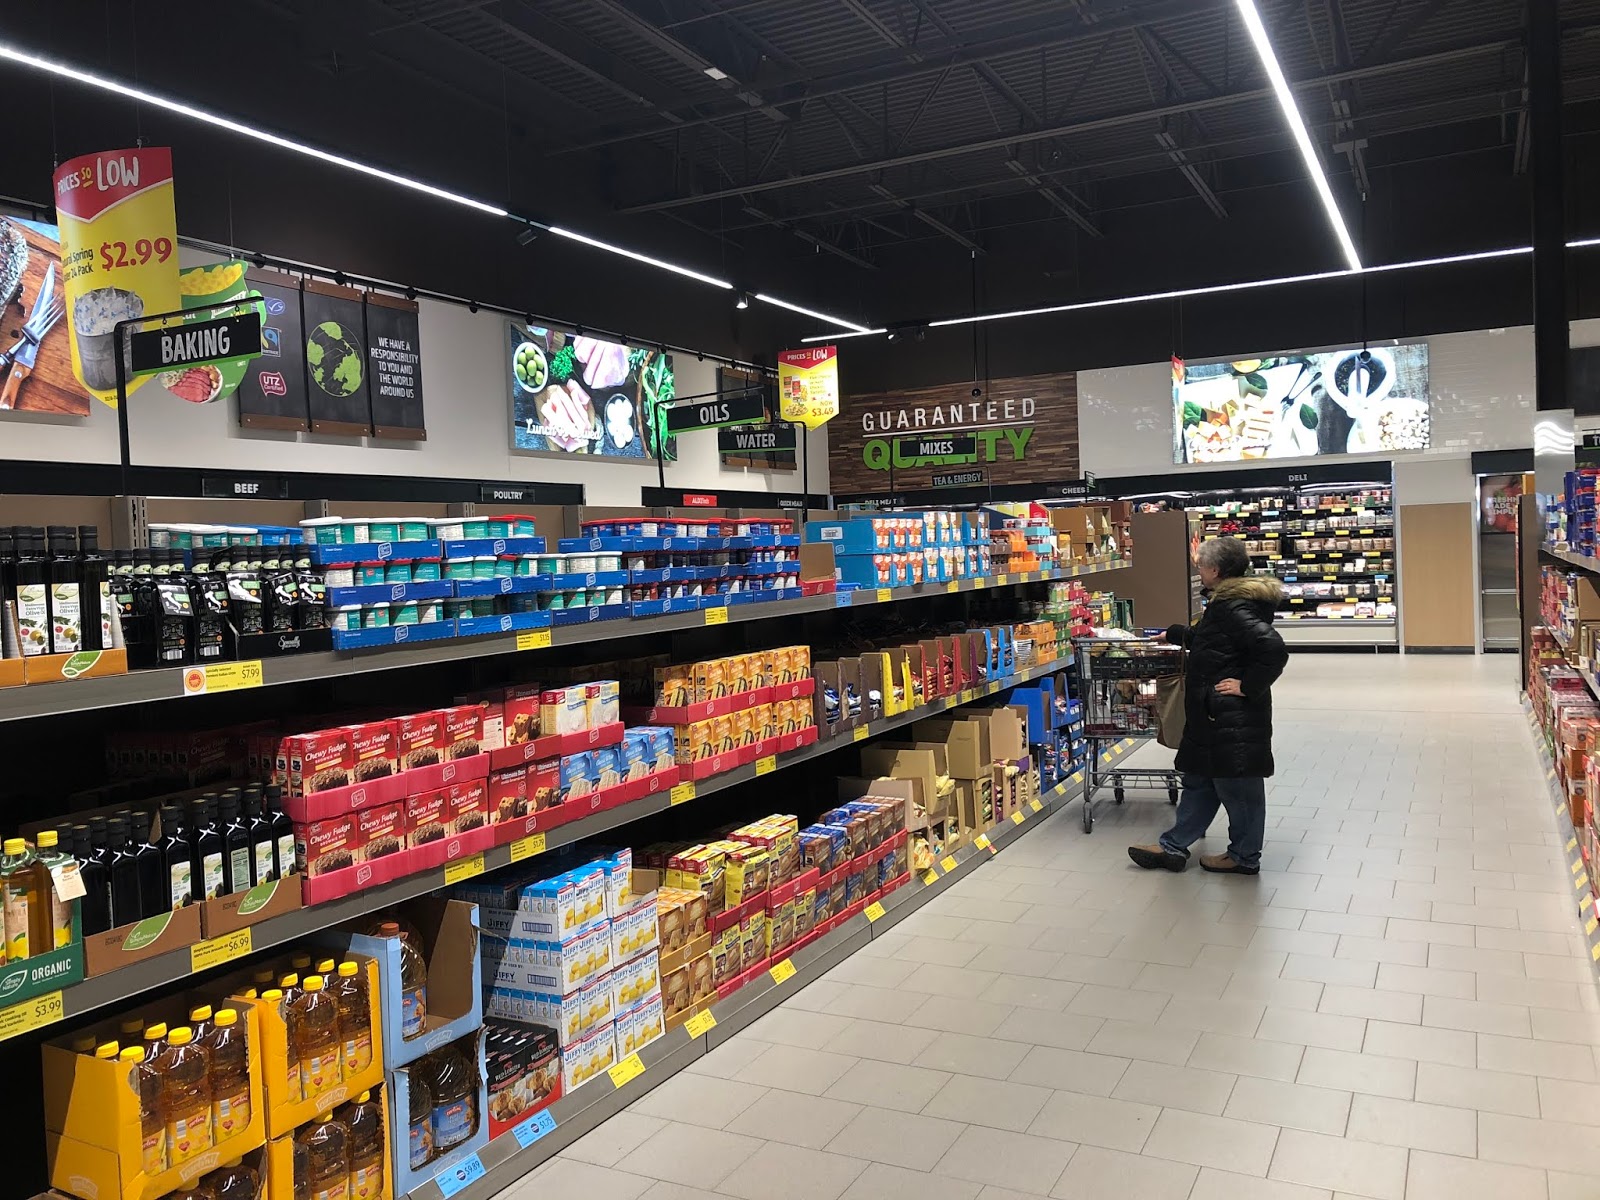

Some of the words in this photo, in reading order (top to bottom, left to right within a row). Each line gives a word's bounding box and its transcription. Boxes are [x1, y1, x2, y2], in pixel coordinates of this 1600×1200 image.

[58, 172, 80, 195] PRICES
[81, 167, 92, 181] SO
[97, 156, 139, 191] LOW
[73, 248, 94, 262] Spring
[100, 237, 172, 271] $2.99
[71, 267, 77, 278] 24
[77, 262, 94, 276] Pack
[161, 326, 230, 363] BAKING
[378, 337, 389, 347] WE
[389, 339, 406, 350] HAVE
[406, 342, 411, 351] A
[370, 347, 419, 364] RESPONSIBILITY
[787, 352, 806, 361] PRICES
[812, 349, 828, 360] LOW
[378, 361, 387, 371] TO
[386, 362, 399, 373] YOU
[399, 365, 413, 375] AND
[263, 375, 280, 386] UTZ
[379, 373, 391, 384] THE
[391, 374, 414, 386] WORLD
[380, 386, 406, 398] AROUND
[406, 389, 414, 399] US
[700, 403, 730, 424] OILS
[812, 407, 834, 417] $3.49
[863, 398, 1035, 432] GUARANTEED
[736, 433, 776, 448] WATER
[863, 428, 1035, 471] QUTY
[920, 442, 954, 455] MIXES
[933, 476, 947, 486] TEA
[954, 473, 981, 484] ENERGY
[1288, 474, 1308, 482] DELI
[234, 483, 259, 494] BEEF
[493, 490, 523, 500] POULTRY
[241, 668, 260, 680] $7.99
[446, 723, 464, 732] Chewy
[464, 716, 479, 725] Fudge
[371, 733, 391, 742] Fudge
[402, 729, 421, 740] Chewy
[421, 723, 438, 734] Fudge
[305, 749, 327, 762] Chewy
[328, 742, 347, 754] Fudge
[450, 795, 467, 806] Chewy
[467, 787, 482, 798] Fudge
[408, 806, 426, 818] Chewy
[427, 798, 444, 810] Fudge
[360, 816, 380, 831] Chewy
[381, 811, 398, 822] Fudge
[310, 831, 332, 845] Chewy
[332, 823, 351, 834] Fudge
[613, 871, 627, 881] JIFFY
[589, 878, 605, 889] JIFFY
[559, 892, 573, 903] JIFFY
[644, 907, 657, 917] JIFFY
[487, 918, 509, 931] JIFFY
[629, 914, 644, 925] JIFFY
[613, 921, 628, 932] JIFFY
[595, 929, 610, 941] JIFFY
[228, 936, 249, 952] $6.99
[579, 937, 595, 949] JIFFY
[563, 945, 579, 958] JIFFY
[644, 954, 657, 965] JIFFY
[31, 958, 72, 981] ORGANIC
[492, 969, 516, 980] JIFFY
[613, 969, 629, 981] JIFFY
[629, 963, 644, 974] JIFFY
[597, 980, 611, 992] JIFFY
[581, 988, 597, 1001] JIFFY
[35, 1000, 61, 1018] $3.99
[562, 998, 579, 1010] JIFFY
[648, 1002, 662, 1013] JIFFY
[5, 1014, 21, 1022] Cooking
[634, 1010, 649, 1022] JIFFY
[617, 1020, 632, 1031] JIFFY
[598, 1029, 614, 1041] JIFFY
[582, 1039, 598, 1052] JIFFY
[564, 1048, 581, 1062] JIFFY
[494, 1069, 506, 1082] RED
[504, 1062, 521, 1076] LOBSTER
[539, 1117, 554, 1130] $1.75
[465, 1160, 482, 1176] $9.89
